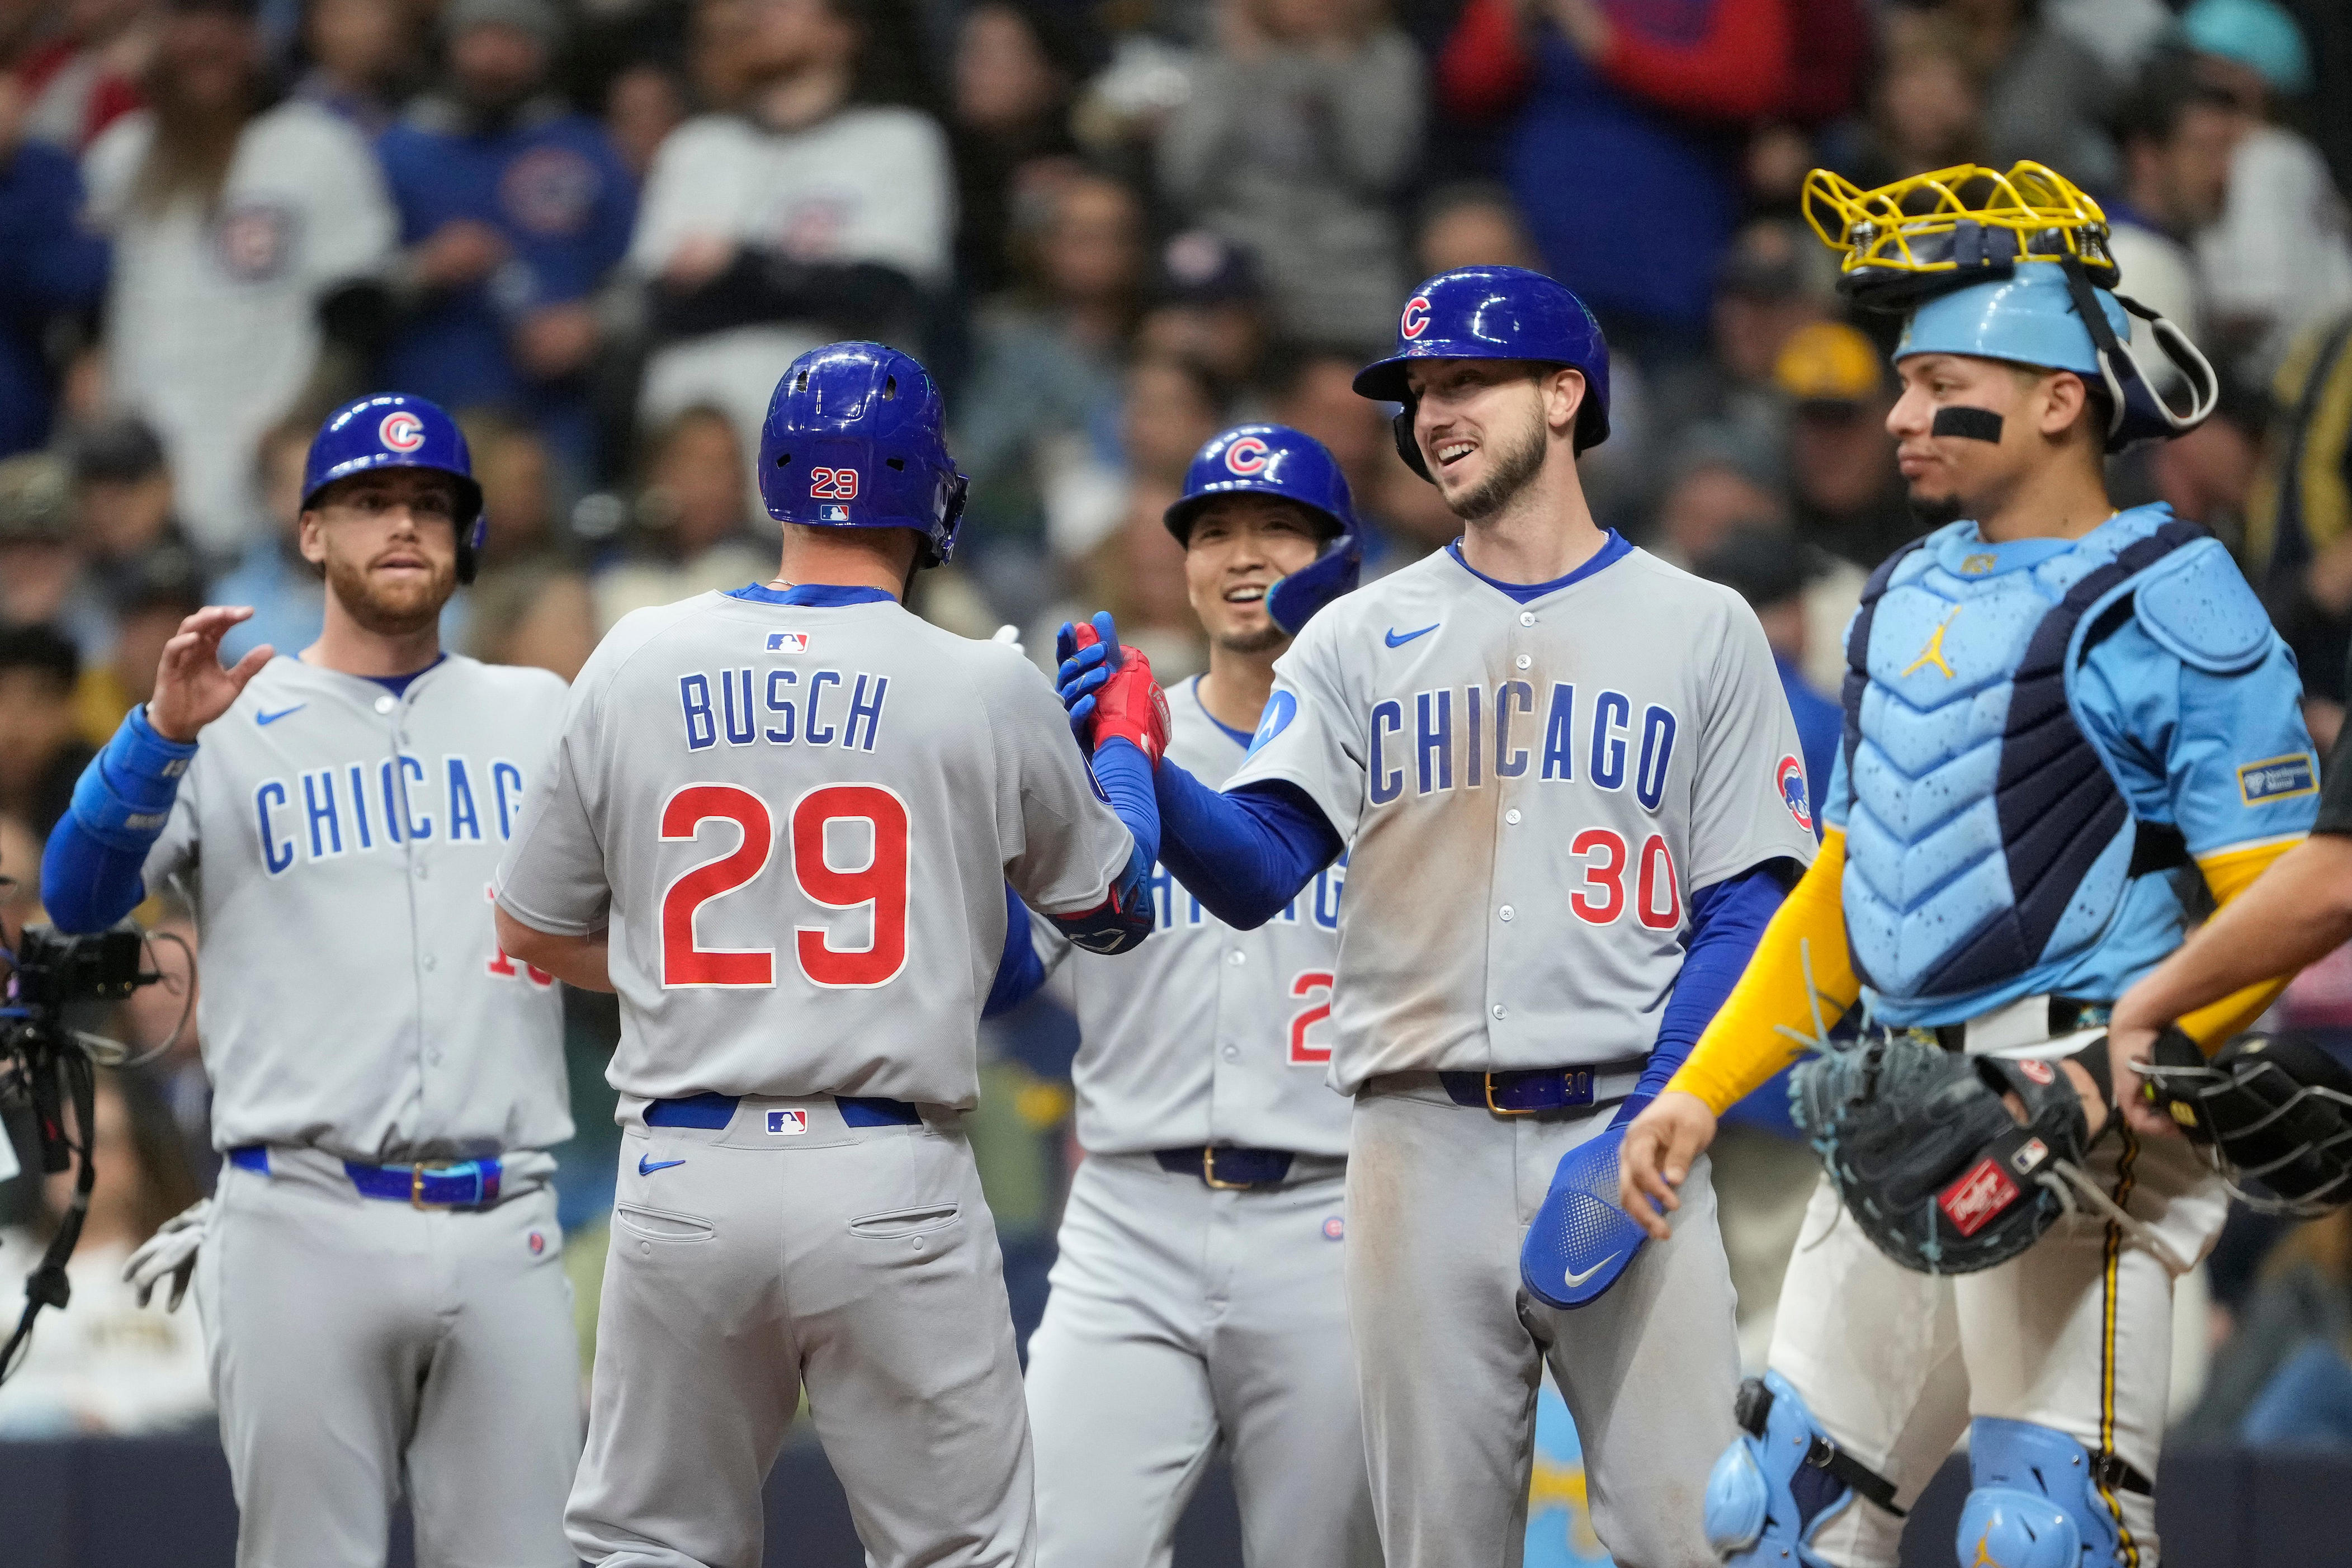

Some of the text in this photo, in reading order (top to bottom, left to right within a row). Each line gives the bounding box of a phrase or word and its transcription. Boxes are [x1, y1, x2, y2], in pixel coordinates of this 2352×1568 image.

[810, 466, 858, 499] 29
[678, 667, 891, 754] BUSCH
[1368, 678, 1678, 813] CHICAGO
[252, 754, 526, 881] CHICAG
[659, 782, 911, 989] 29
[1569, 826, 1681, 932] 30
